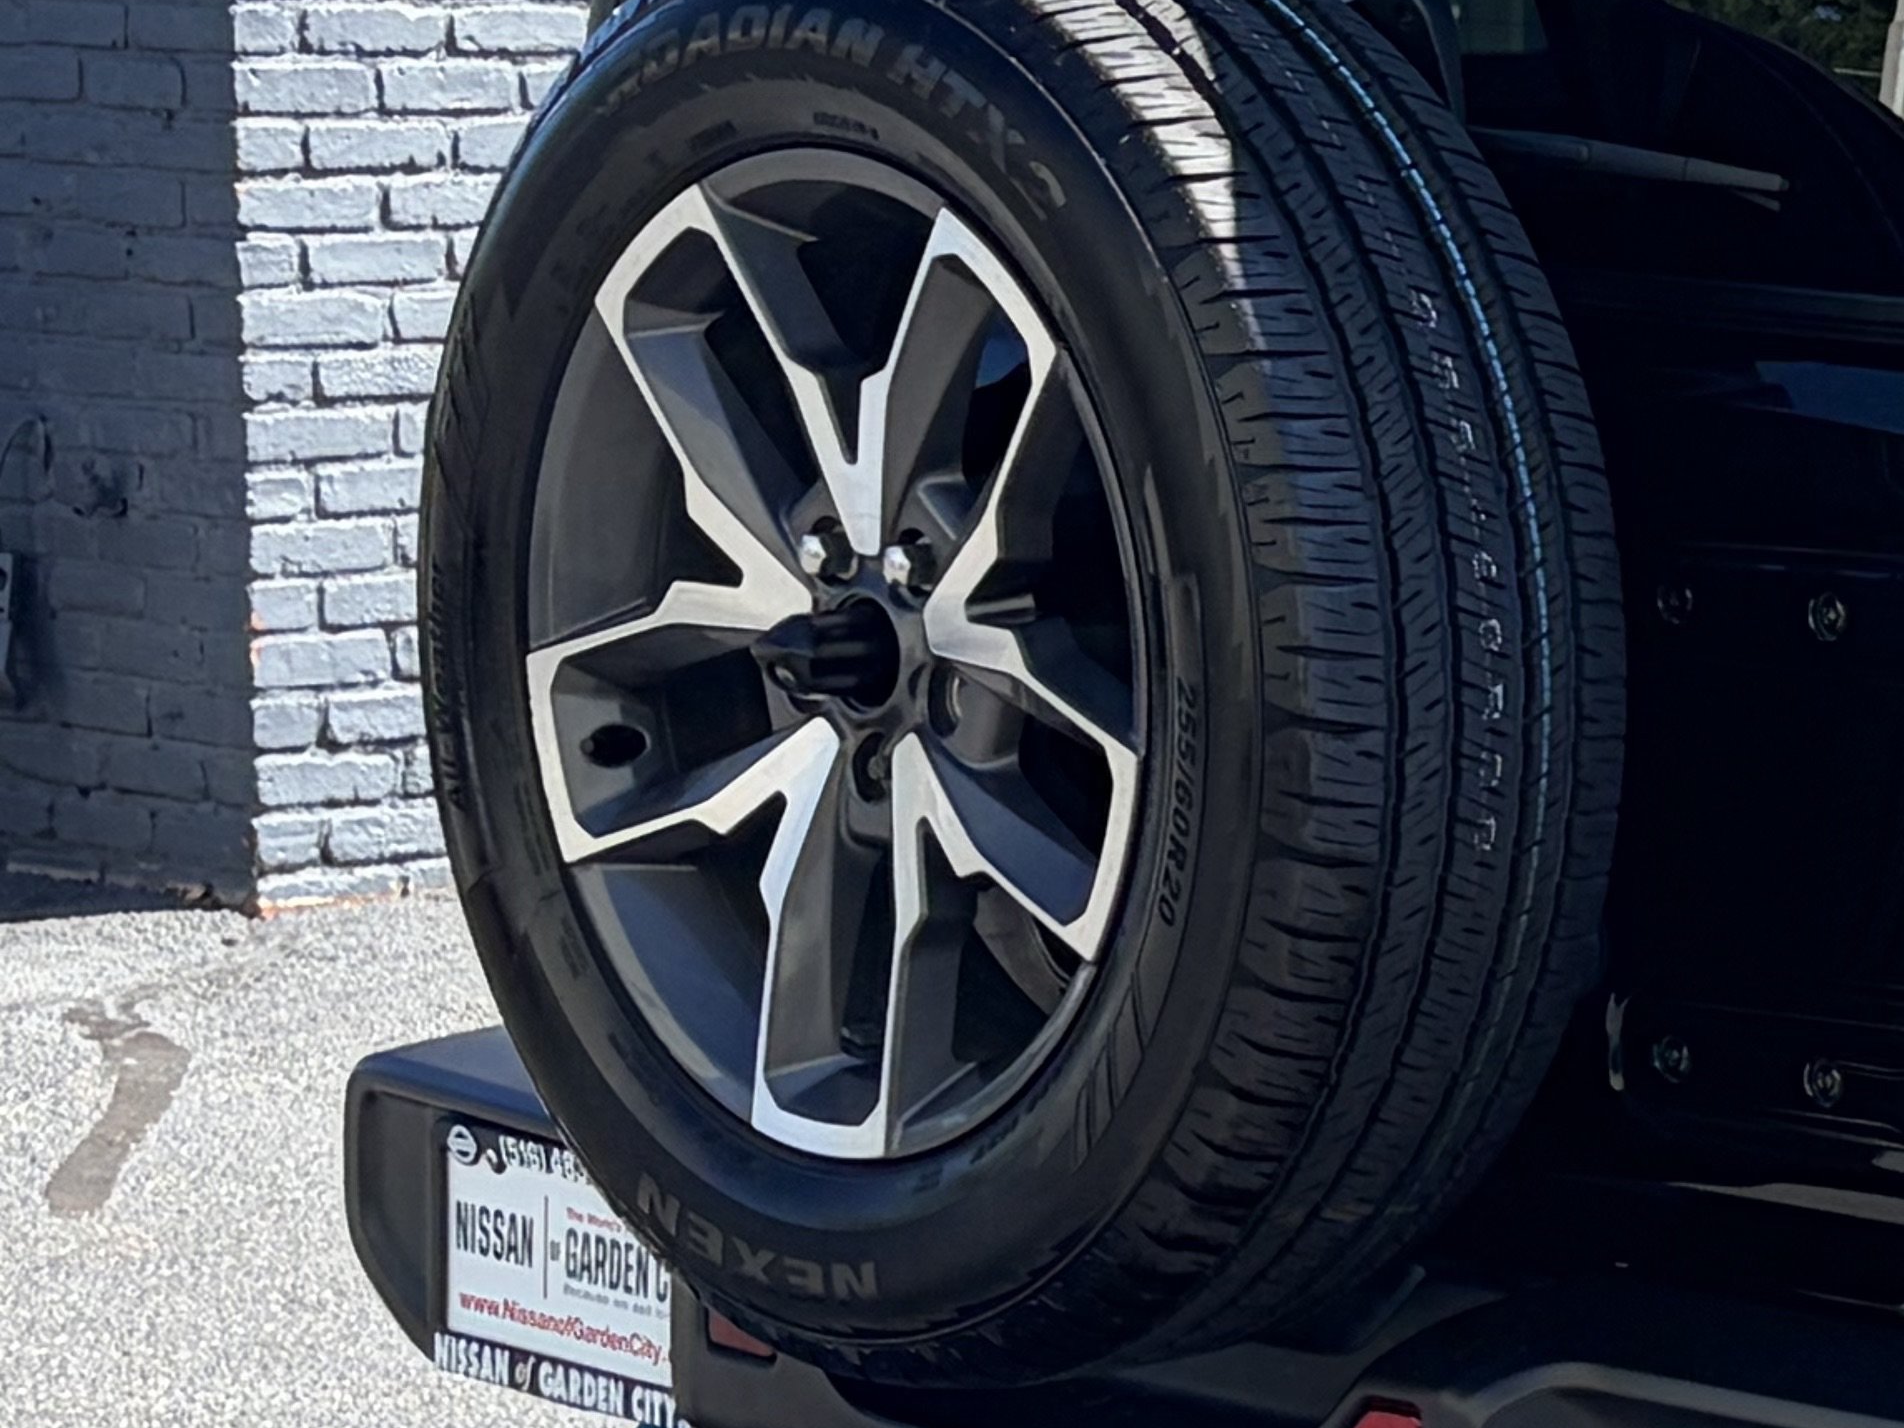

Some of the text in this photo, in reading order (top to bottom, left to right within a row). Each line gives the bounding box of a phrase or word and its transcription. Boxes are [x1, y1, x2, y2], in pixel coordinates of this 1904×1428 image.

[1157, 676, 1197, 928] 255/60R20
[455, 1199, 534, 1269] NISSAN
[565, 1227, 649, 1300] GARDEN
[637, 1172, 879, 1301] NEXEN
[434, 1332, 509, 1387] NISSAN
[538, 1363, 625, 1416] GARDEN
